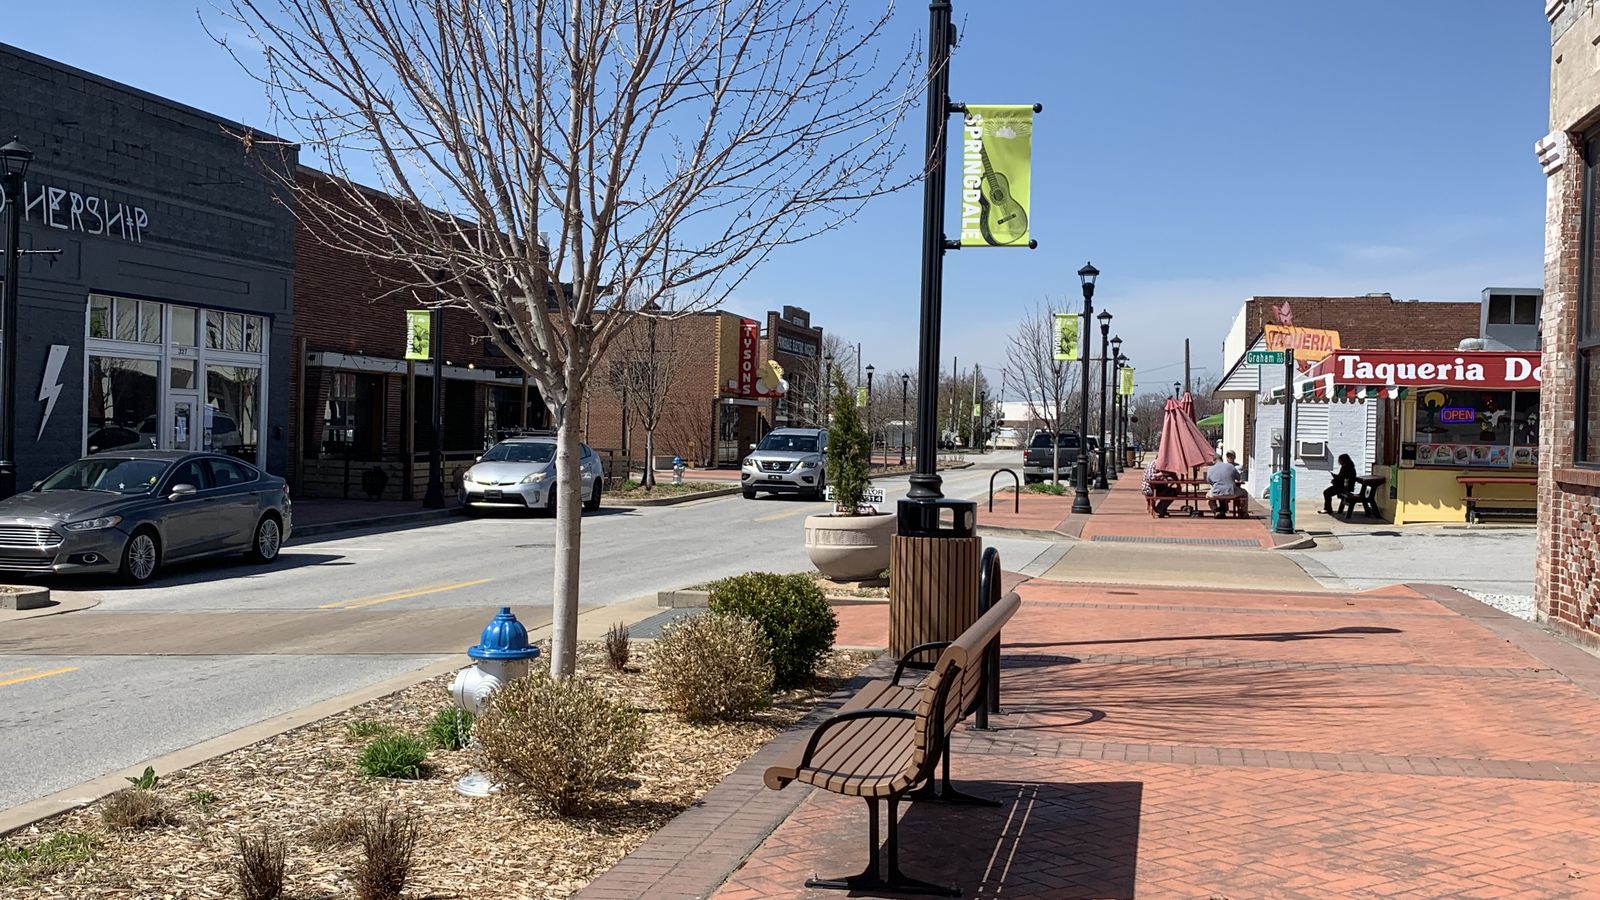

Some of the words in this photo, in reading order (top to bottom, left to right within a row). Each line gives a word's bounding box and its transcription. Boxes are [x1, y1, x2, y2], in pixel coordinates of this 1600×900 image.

[961, 114, 983, 239] SPRINGDALE
[0, 181, 148, 243] HERSHIP
[1269, 330, 1333, 351] TAQUERIA
[742, 327, 752, 395] TYSONS
[1248, 352, 1274, 363] Graham
[1338, 355, 1485, 385] Taqueria
[1443, 409, 1473, 420] OPEN
